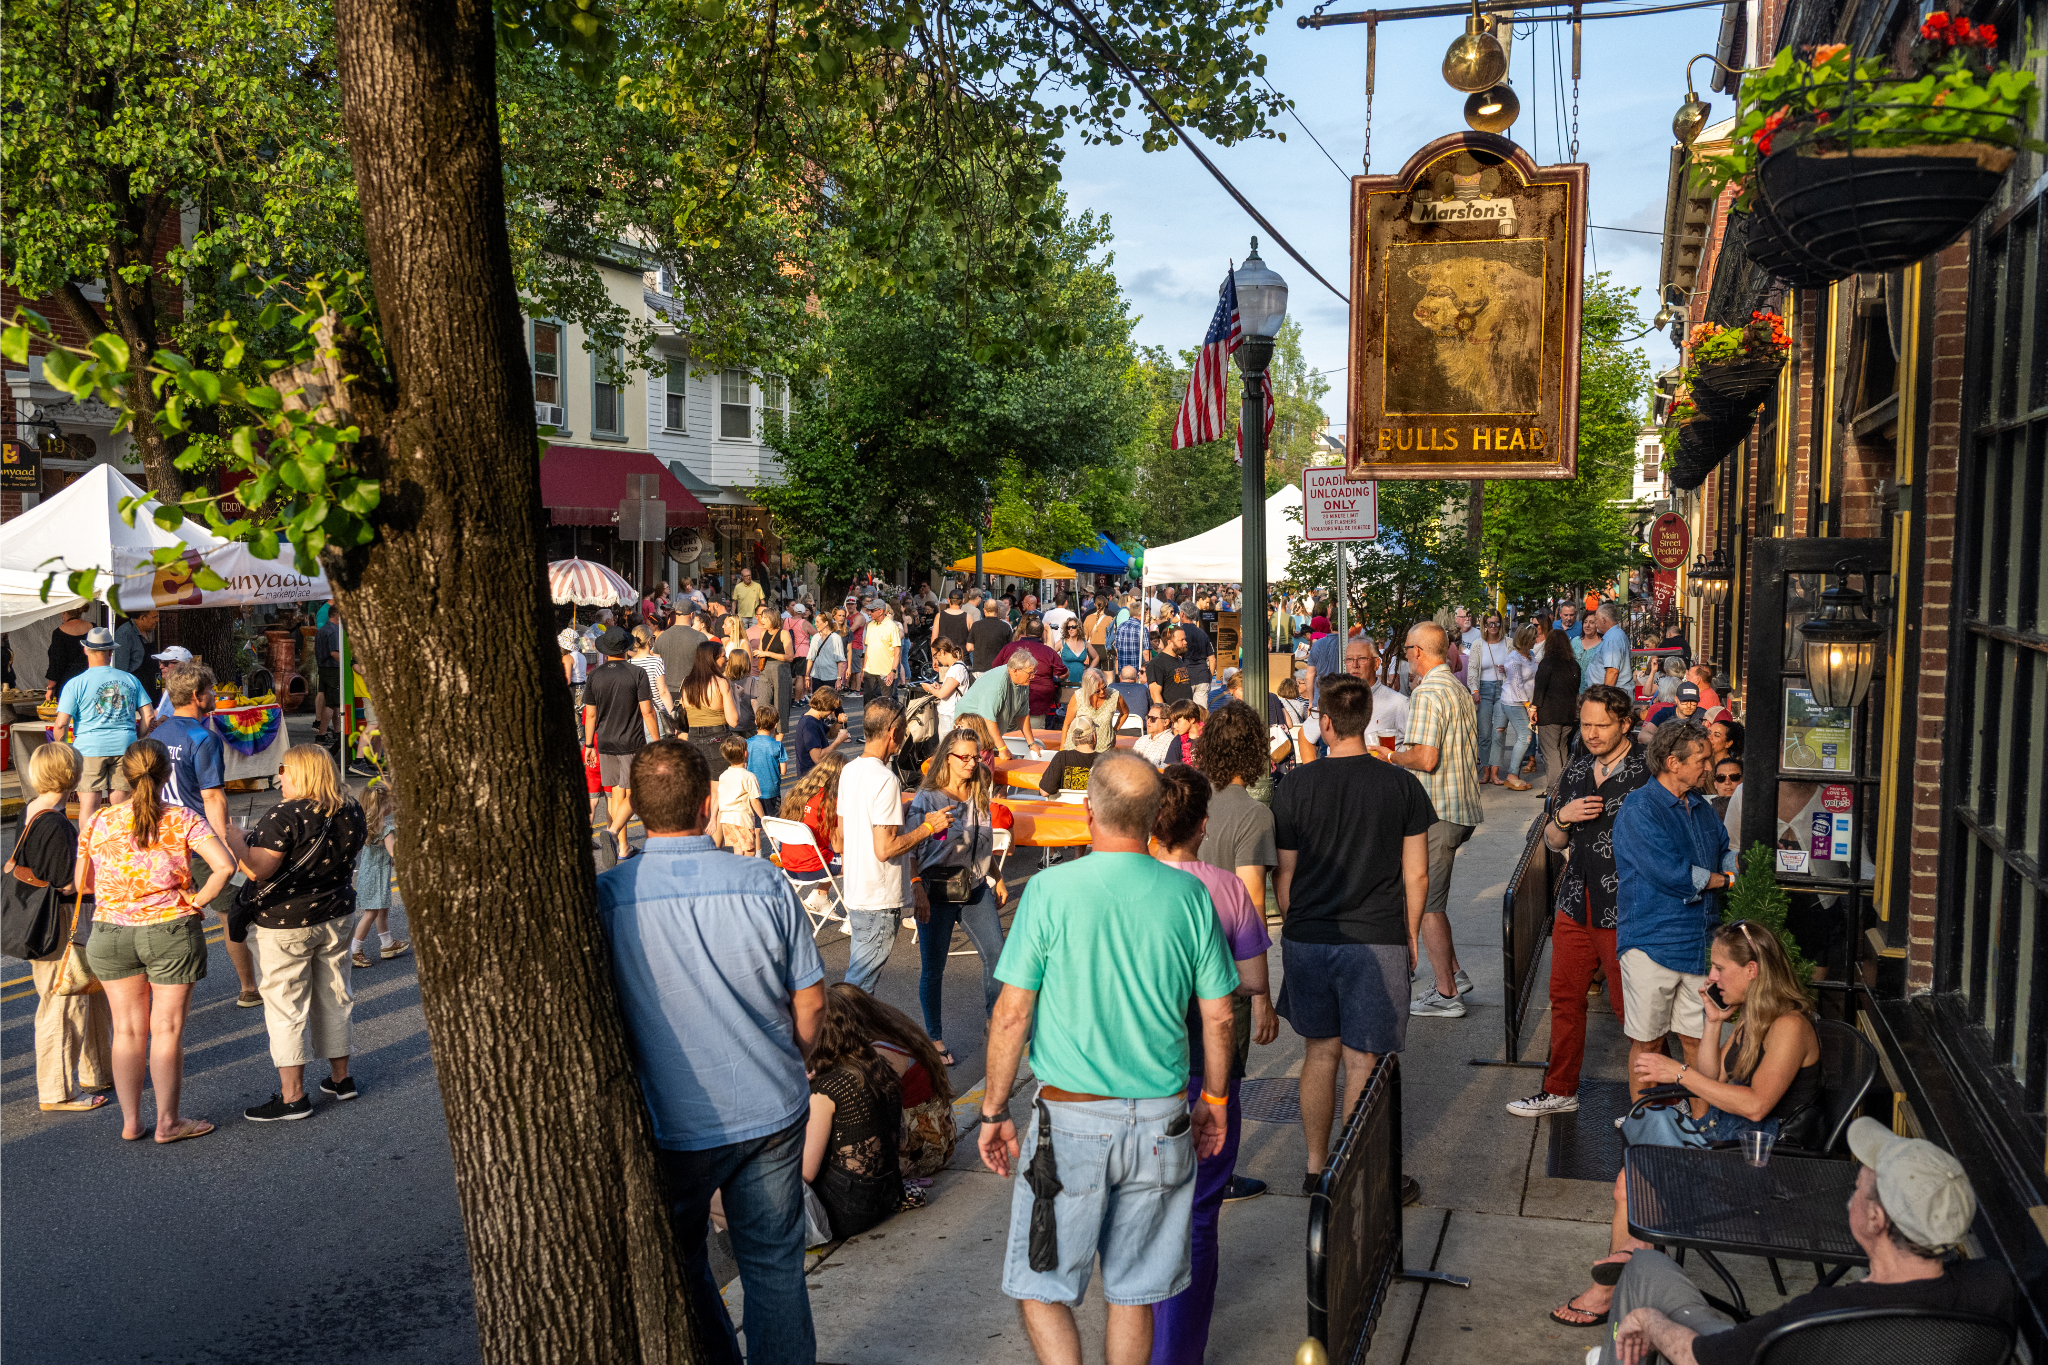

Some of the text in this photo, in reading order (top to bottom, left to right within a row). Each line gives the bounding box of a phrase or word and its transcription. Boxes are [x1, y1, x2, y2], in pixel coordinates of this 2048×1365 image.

[1420, 202, 1507, 220] Marston's
[1378, 427, 1549, 451] BULLS HEAD
[46, 438, 66, 454] 19
[1310, 487, 1370, 499] UNLOADING
[1324, 499, 1357, 511] ONLY
[1656, 547, 1684, 555] Peddler
[265, 587, 311, 600] marketplace
[1824, 799, 1842, 808] yelp
